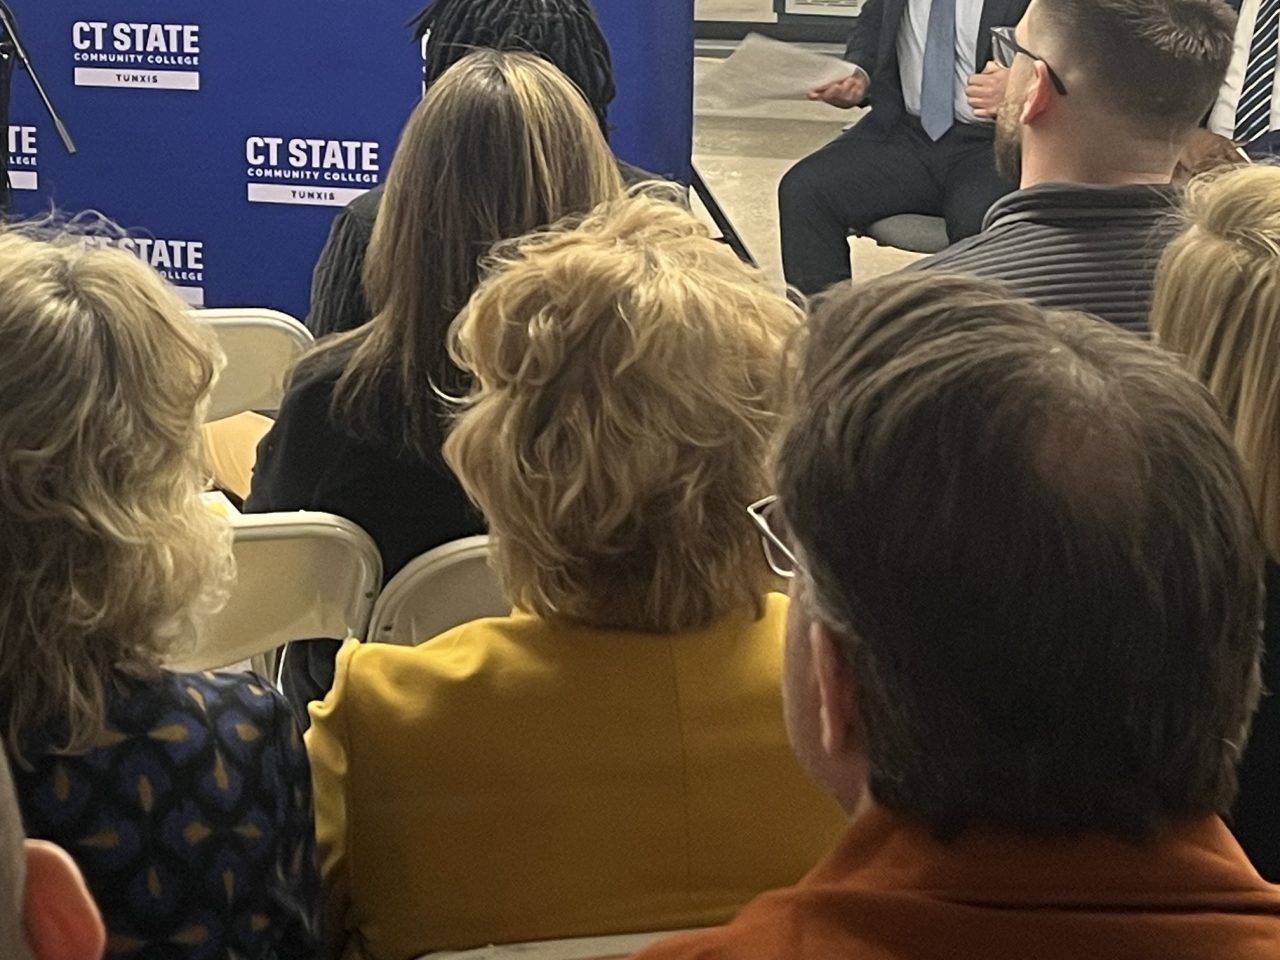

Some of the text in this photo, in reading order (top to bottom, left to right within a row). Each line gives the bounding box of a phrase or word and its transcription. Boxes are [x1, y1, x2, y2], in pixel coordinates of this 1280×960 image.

[72, 21, 200, 54] CT STATE
[73, 52, 199, 66] COMMUNITY COLLEGE
[115, 73, 159, 84] TUNXIS
[246, 136, 380, 171] CT STATE
[247, 167, 378, 183] COMMUNITY COLLEGE
[290, 191, 335, 201] TUNXIS
[159, 270, 203, 281] OLLEGE
